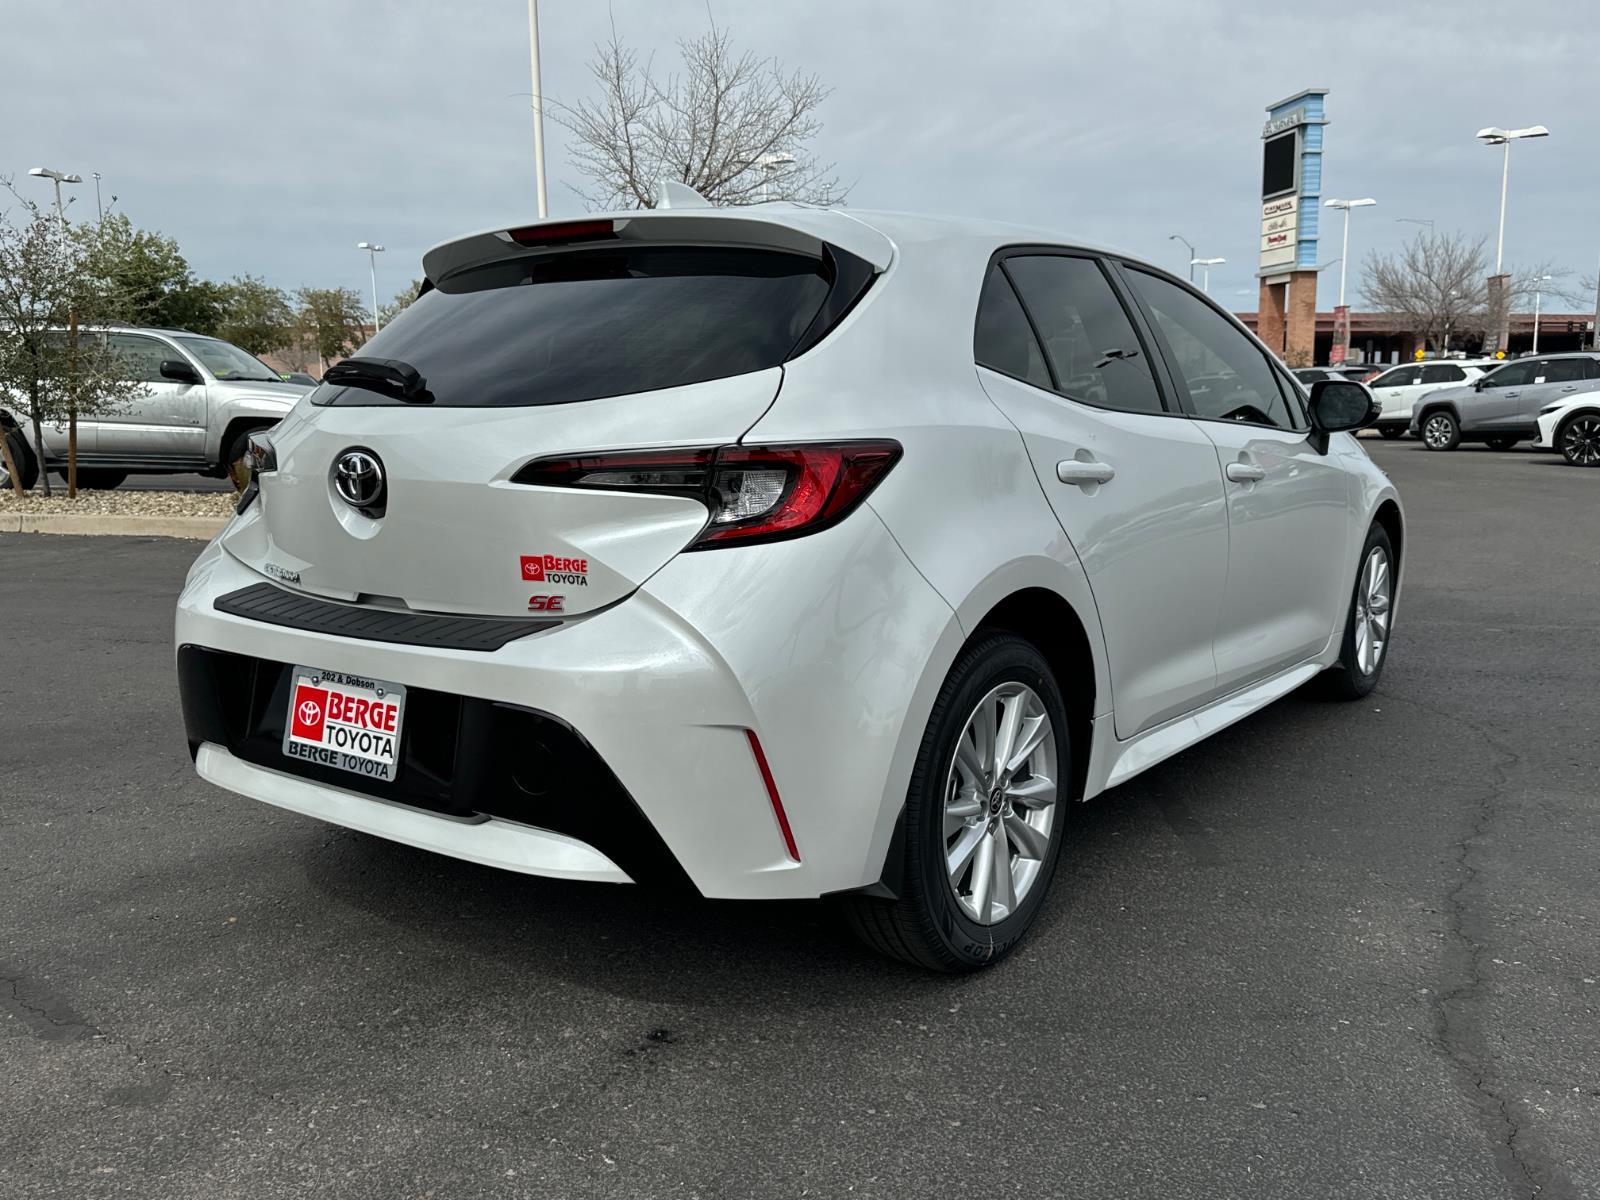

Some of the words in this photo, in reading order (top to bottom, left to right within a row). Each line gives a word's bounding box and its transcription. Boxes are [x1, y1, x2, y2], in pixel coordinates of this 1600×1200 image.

[543, 554, 588, 573] BERGE
[545, 573, 588, 586] TOYOTA
[528, 595, 565, 611] SE
[321, 671, 336, 682] 202
[337, 675, 344, 683] &
[346, 676, 375, 689] Dobson
[328, 691, 398, 732] BERGE
[326, 724, 394, 759] TOYOTA
[288, 741, 338, 765] BERGE
[342, 753, 389, 779] TOYOTA
